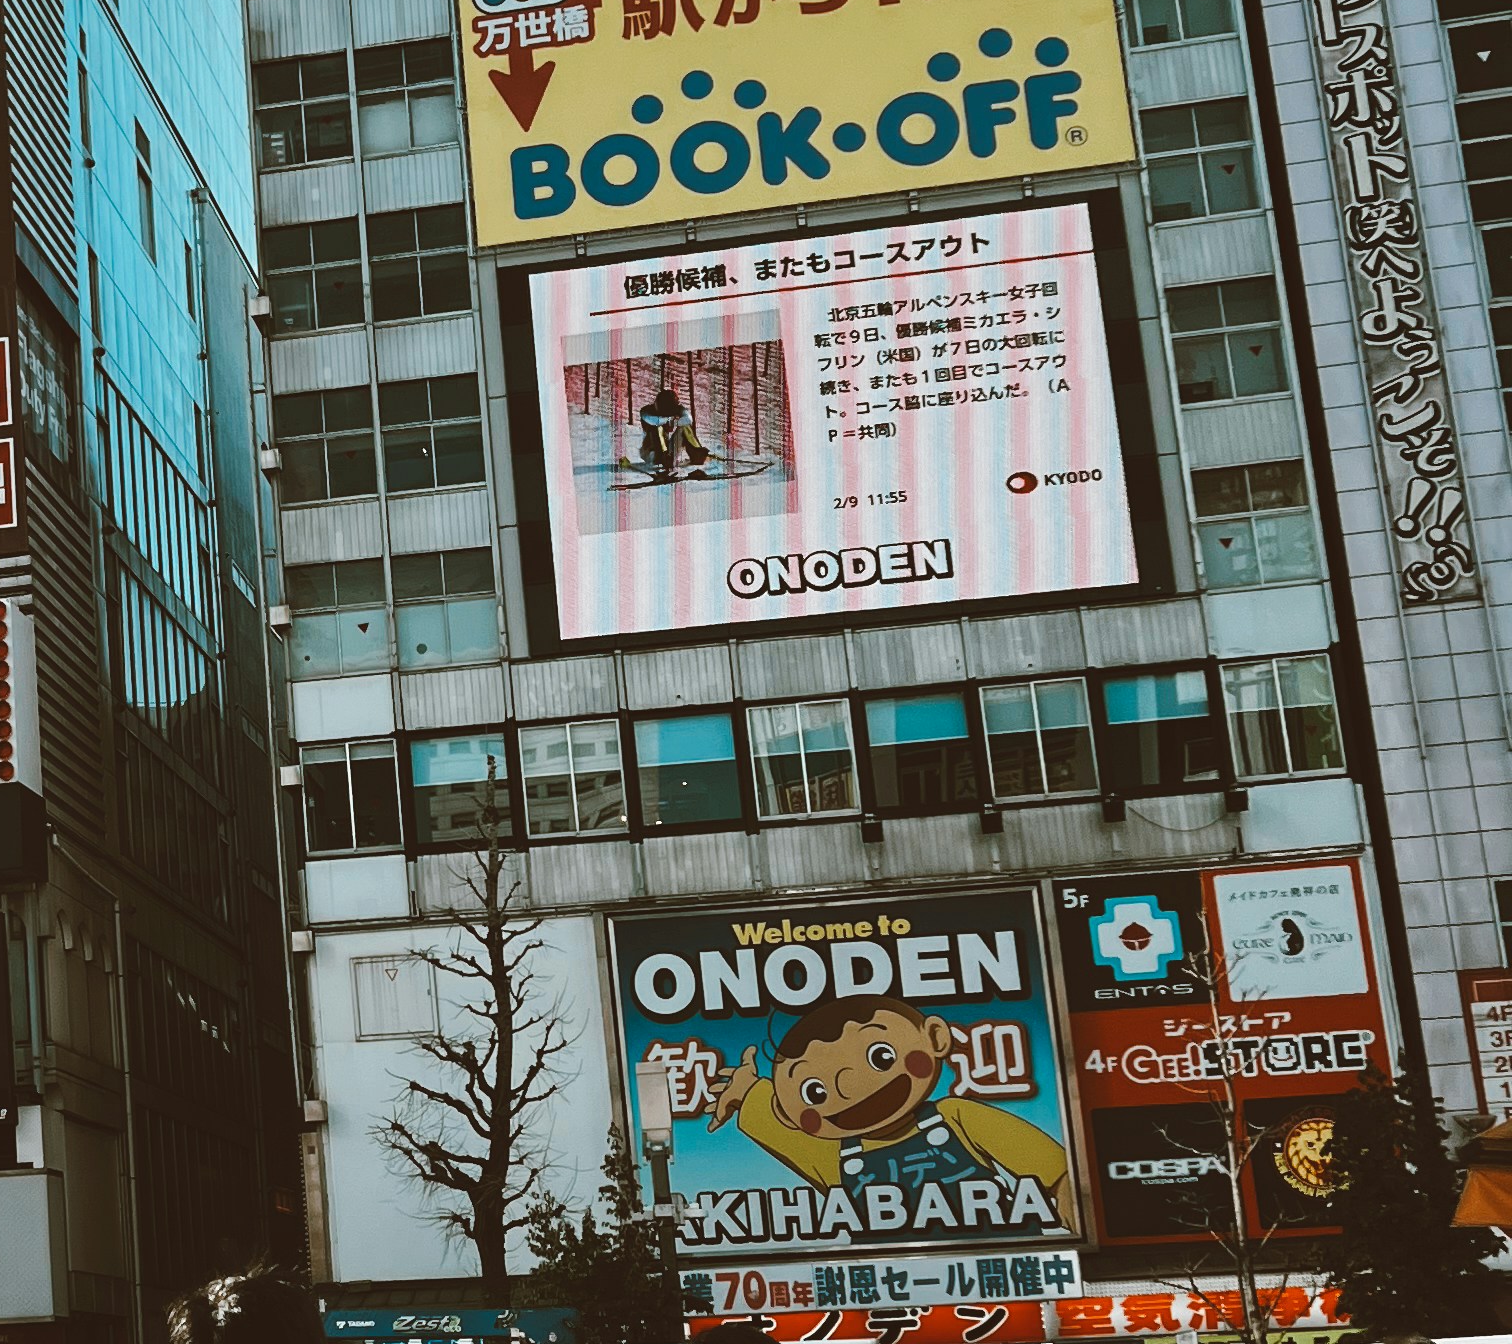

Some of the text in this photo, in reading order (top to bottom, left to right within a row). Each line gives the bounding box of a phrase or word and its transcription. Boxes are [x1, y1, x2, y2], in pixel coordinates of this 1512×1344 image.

[476, 3, 592, 53] 万世橋
[624, 231, 991, 301] 優勝候補、またもコースアウト
[828, 281, 1058, 323] 北京五輪アルペンスキー女子回
[1043, 468, 1104, 487] KYODO
[833, 489, 908, 510] 2/9 11:55
[726, 538, 955, 599] ONODEN
[1063, 889, 1089, 909] 5F
[732, 914, 911, 946] Welcome to
[633, 930, 1023, 1015] ONODEN
[1163, 1012, 1291, 1037] ジーストア
[949, 1023, 1031, 1096] 迎
[1084, 1049, 1118, 1074] 4F
[1108, 1157, 1225, 1180] COSPA
